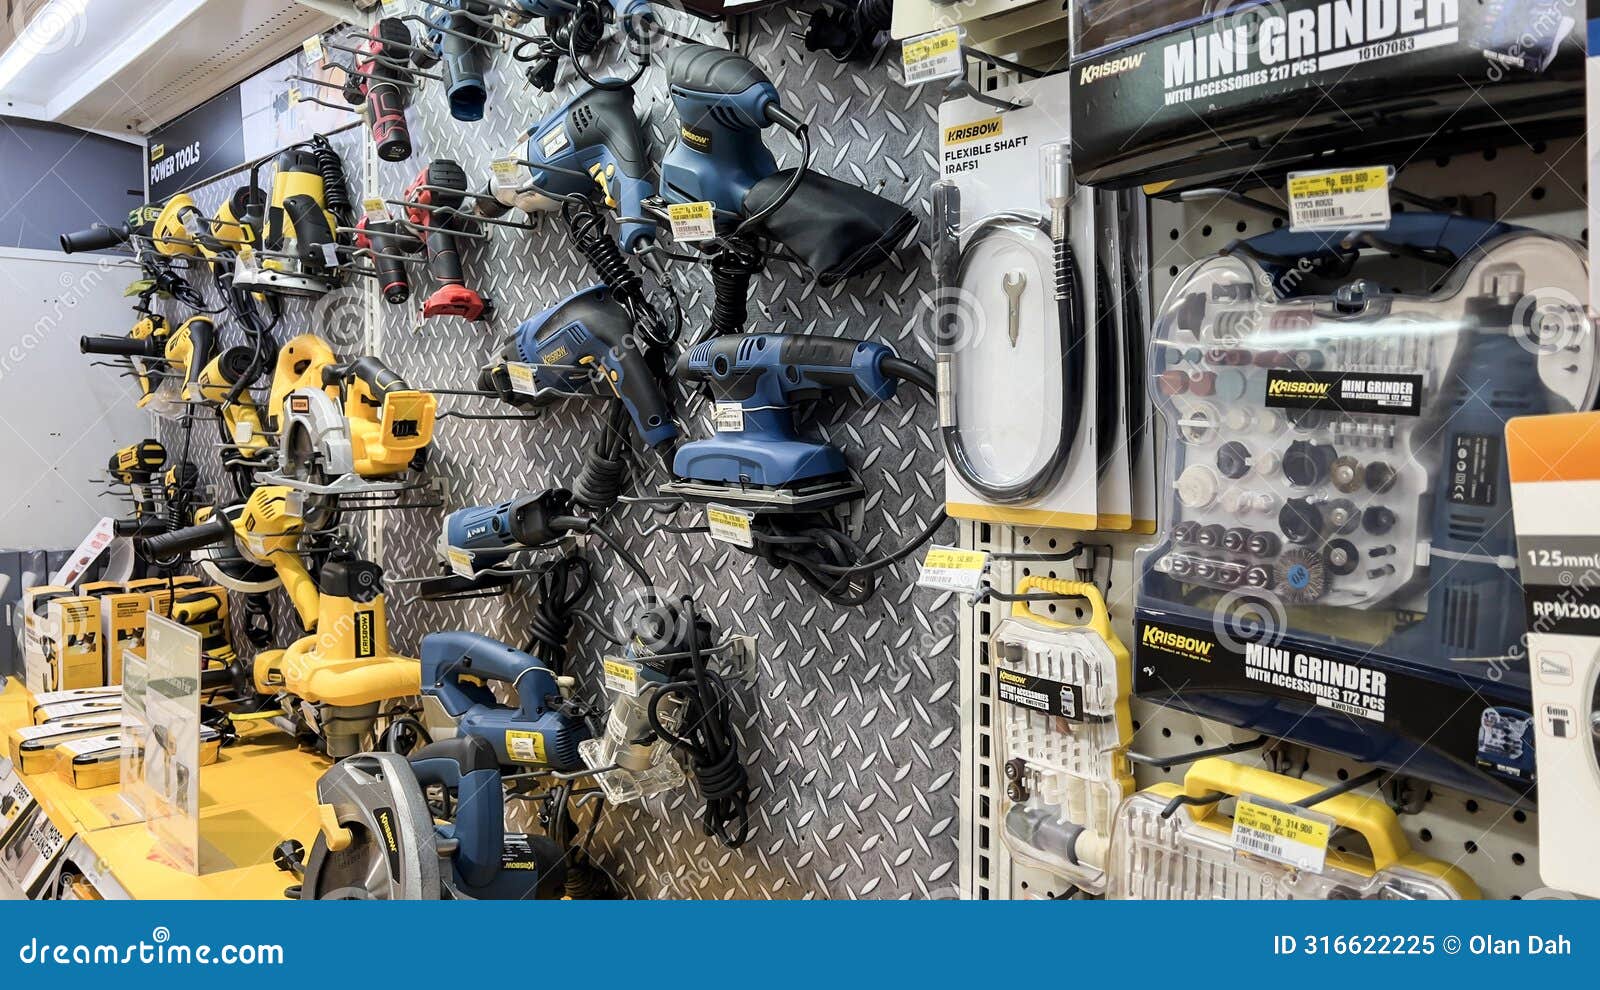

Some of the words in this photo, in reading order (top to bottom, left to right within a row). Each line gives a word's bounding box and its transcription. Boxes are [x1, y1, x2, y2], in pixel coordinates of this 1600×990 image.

[1164, 25, 1248, 89] MINI
[1359, 38, 1415, 60] 10107083
[1080, 54, 1143, 86] KRISBOW
[1164, 87, 1192, 105] WITH
[1193, 69, 1268, 98] ACCESSORIES
[1270, 66, 1290, 82] 217
[1291, 58, 1317, 78] PCS
[947, 121, 1000, 142] KRISBOW
[151, 155, 174, 184] POWER
[175, 141, 200, 172] TOOLS
[945, 144, 991, 161] FLEXIBLE
[994, 136, 1028, 152] SHAFT
[945, 160, 979, 174] IRAFS1
[1269, 379, 1328, 394] KRISBOW
[1341, 380, 1366, 392] MINI
[1367, 381, 1413, 395] GRINDER
[1143, 625, 1211, 655] KRISBOW
[1245, 642, 1290, 674] MINI
[1294, 653, 1387, 697] GRINDER
[1245, 666, 1271, 683] WITH
[1271, 674, 1340, 700] ACCESSORIES
[1342, 690, 1360, 707] 172
[1362, 693, 1385, 711] PCS
